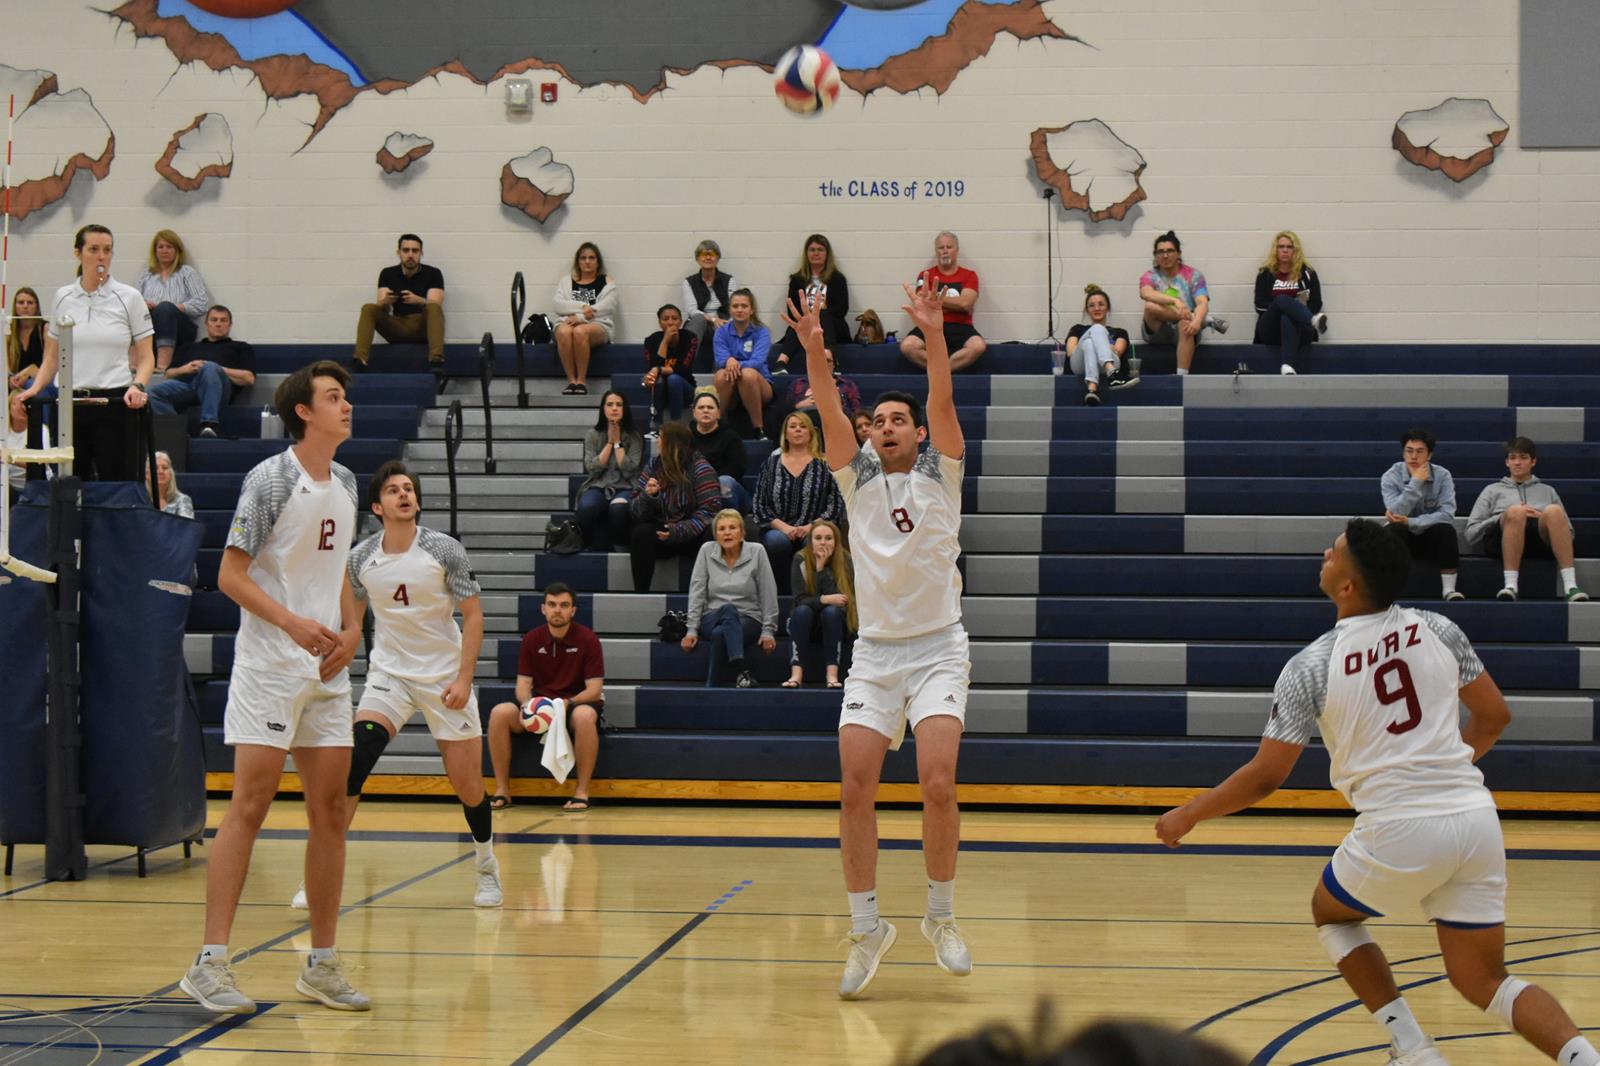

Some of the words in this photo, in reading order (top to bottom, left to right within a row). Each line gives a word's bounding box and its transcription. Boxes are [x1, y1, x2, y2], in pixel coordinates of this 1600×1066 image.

[818, 180, 843, 197] the
[848, 180, 900, 197] CLASS
[903, 181, 917, 200] of
[924, 180, 965, 197] 2019
[891, 507, 915, 533] 8
[317, 518, 336, 551] 12
[392, 583, 409, 606] 4
[1374, 658, 1422, 735] 9
